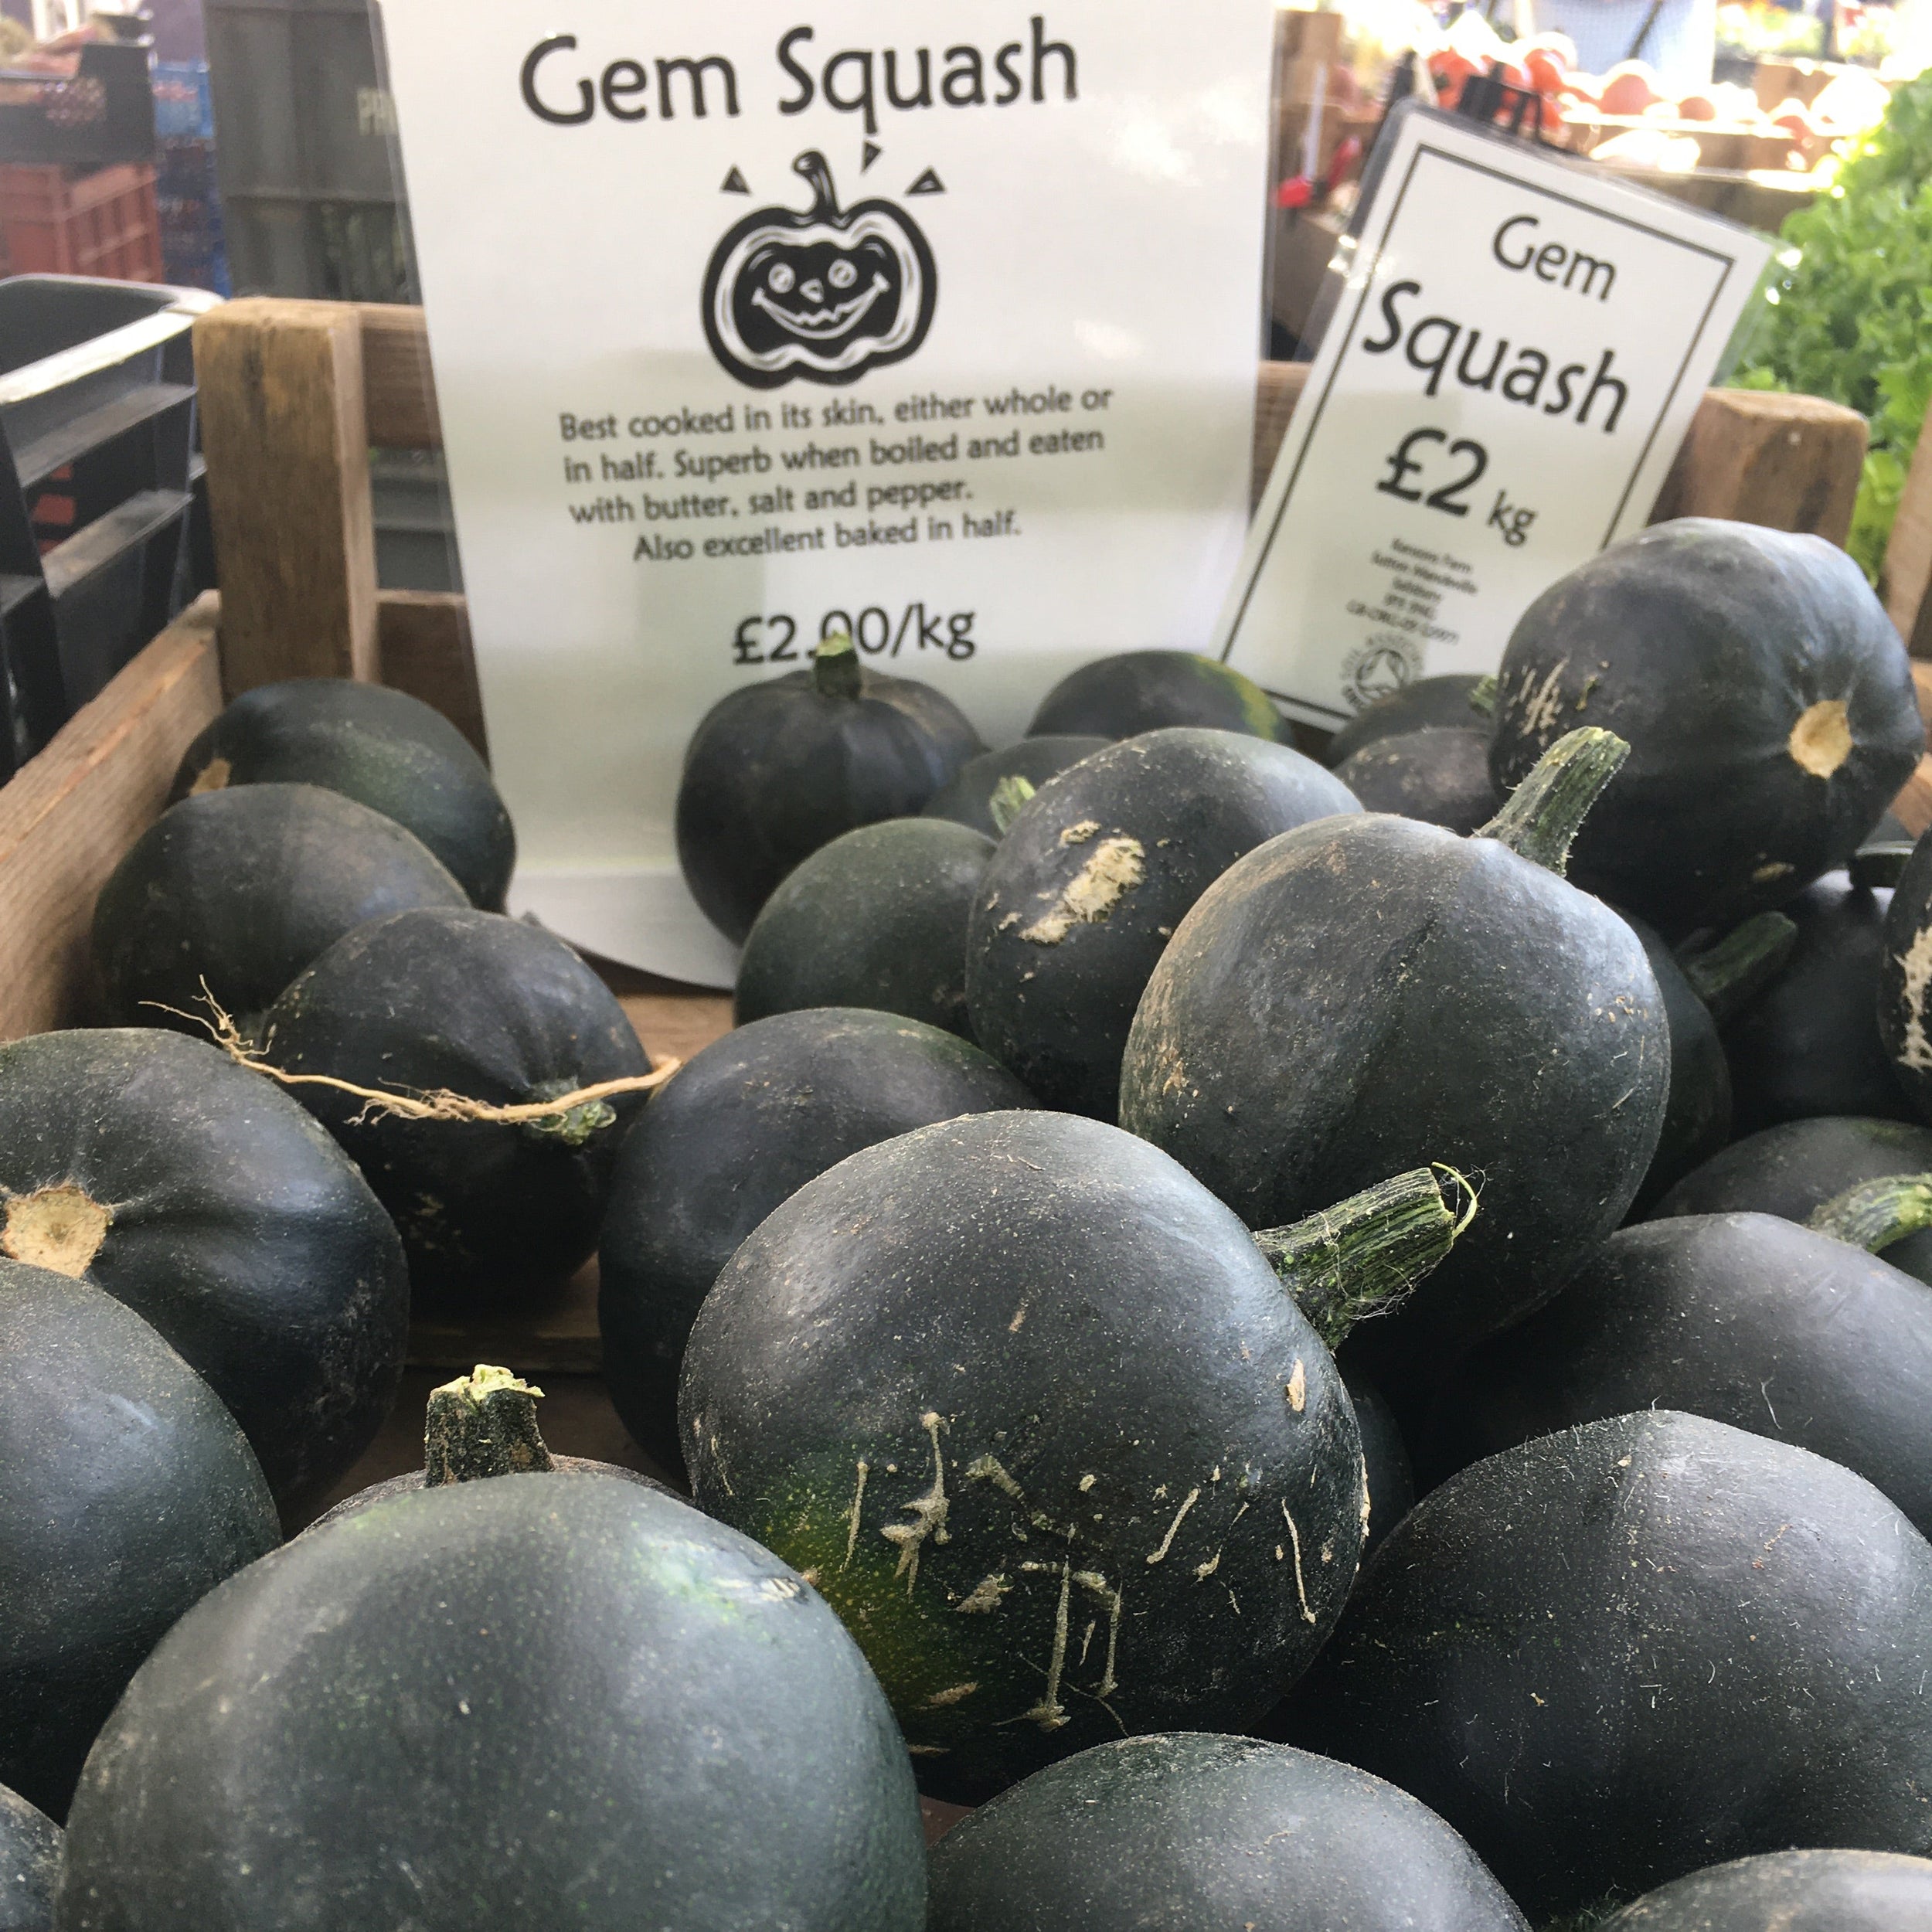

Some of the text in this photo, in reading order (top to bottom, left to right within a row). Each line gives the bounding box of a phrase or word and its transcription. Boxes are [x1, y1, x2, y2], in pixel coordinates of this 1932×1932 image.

[519, 34, 742, 128] Gem
[775, 14, 1079, 138] Squash
[1492, 214, 1617, 303] Gem
[1360, 279, 1630, 434] Squash
[559, 384, 1114, 442] Best cooked in its skin, either whole or
[564, 428, 1105, 484] in half. Superb when boiled and eaten
[1374, 427, 1538, 548] £2 kg
[569, 495, 635, 524] with
[748, 484, 794, 515] salt
[804, 481, 858, 511] and
[866, 479, 973, 513] pepper.
[633, 509, 1022, 562] Also excellent baked in half.
